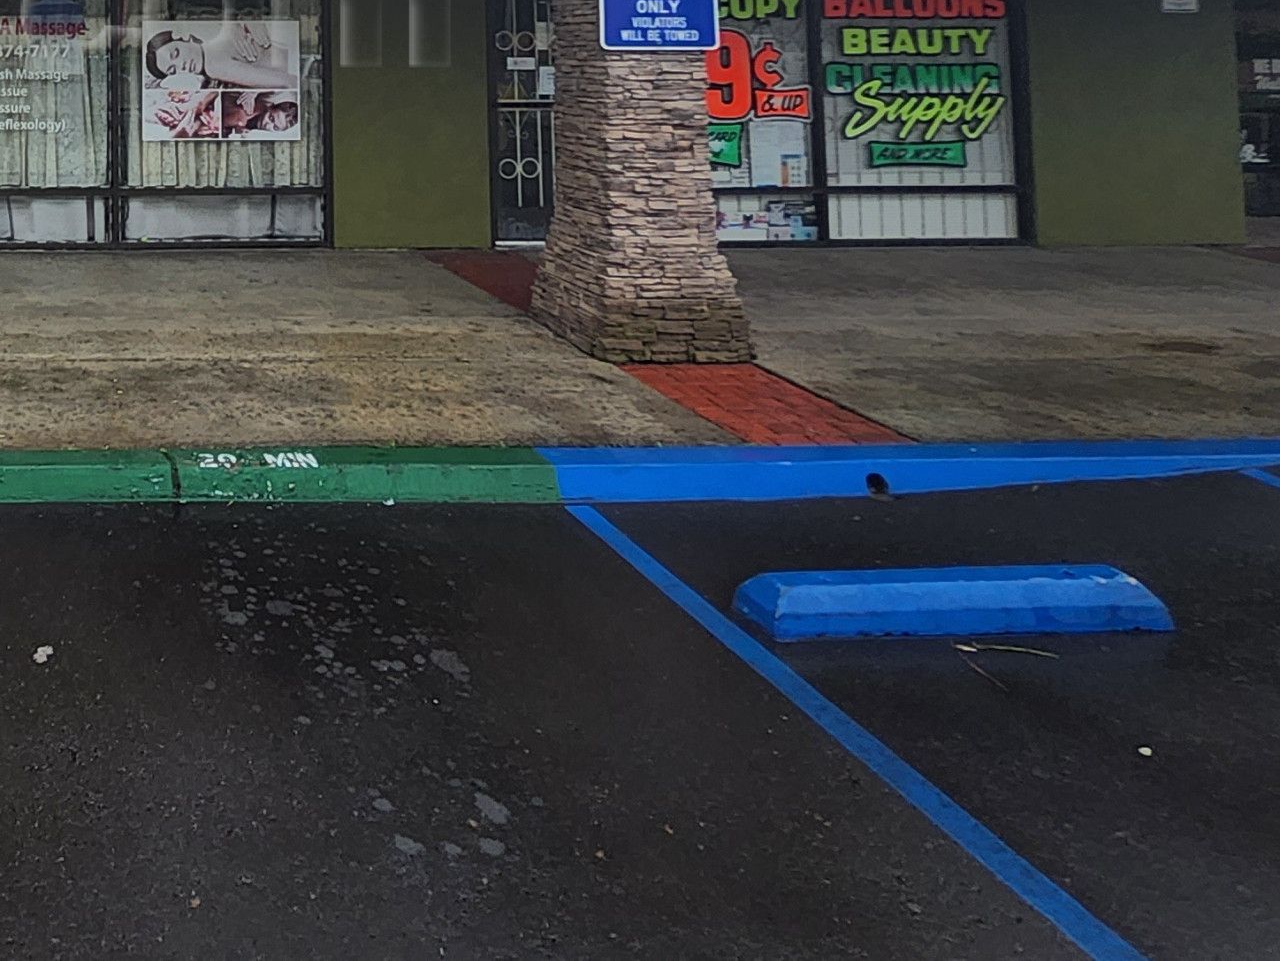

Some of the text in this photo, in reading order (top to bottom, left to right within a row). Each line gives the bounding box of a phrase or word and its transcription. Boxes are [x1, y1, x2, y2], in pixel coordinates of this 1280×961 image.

[636, 0, 680, 13] ONLY
[0, 17, 11, 36] A
[15, 18, 88, 39] Massage
[631, 16, 687, 28] VIOLATORS
[620, 29, 699, 41] WILL BE TOWED
[841, 27, 993, 55] BEAUTY
[15, 69, 69, 83] Massage
[825, 63, 1000, 94] CLEANING
[781, 93, 804, 111] UP
[845, 77, 1005, 140] Supply
[263, 452, 319, 468] MIN
